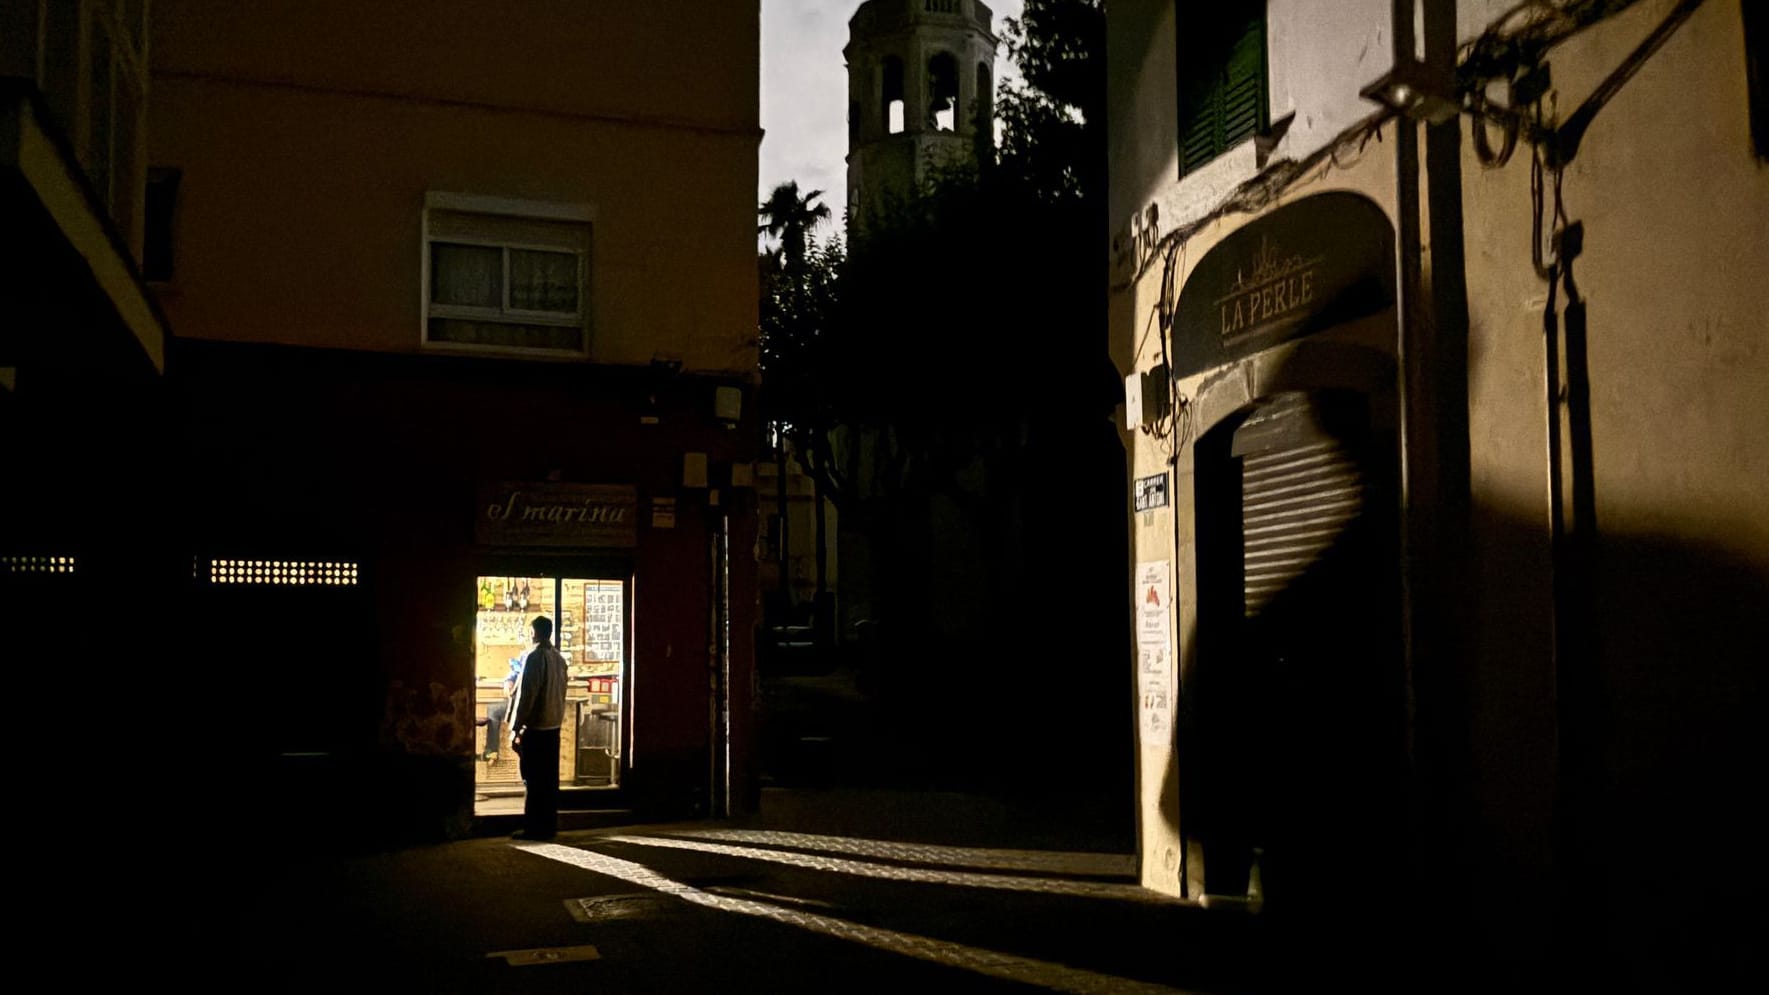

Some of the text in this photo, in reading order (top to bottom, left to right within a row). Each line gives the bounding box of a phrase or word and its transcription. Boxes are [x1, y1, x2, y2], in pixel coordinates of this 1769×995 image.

[1221, 270, 1313, 335] LA PERLE
[521, 499, 626, 523] marina
